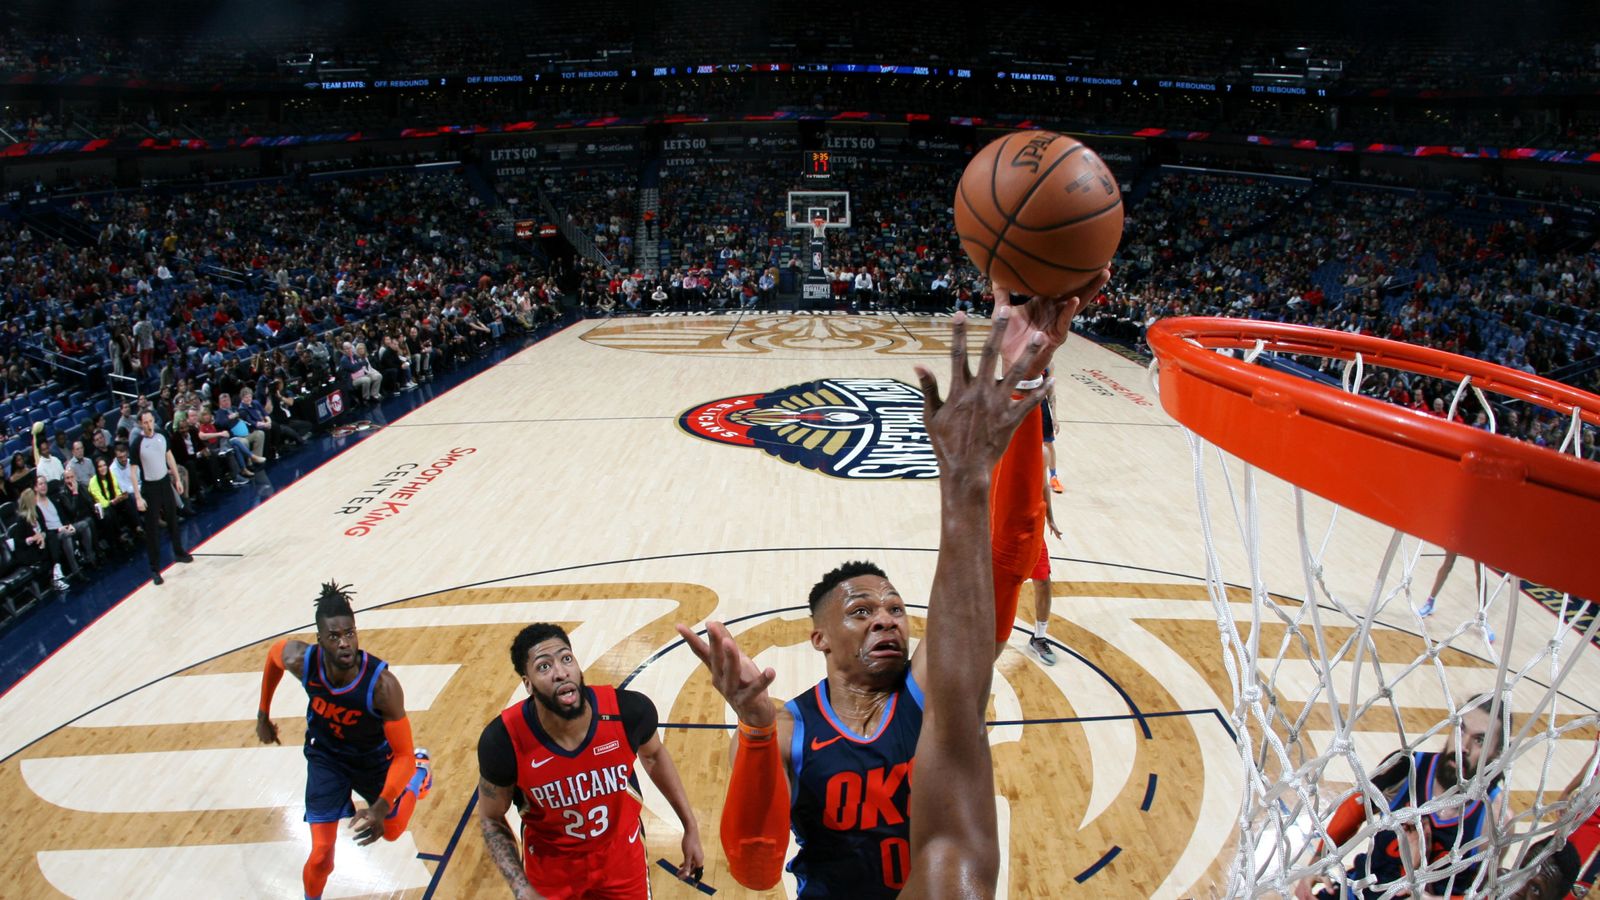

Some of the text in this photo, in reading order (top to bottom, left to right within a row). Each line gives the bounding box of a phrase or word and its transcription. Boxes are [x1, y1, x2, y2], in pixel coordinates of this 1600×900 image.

[578, 70, 619, 78] REBOUNDS
[1010, 72, 1057, 82] TEAM STATS:
[390, 79, 429, 88] REBOUNDS
[440, 78, 446, 86] 2
[484, 75, 523, 83] REBOUNDS
[1082, 77, 1122, 86] REBOUNDS
[1132, 79, 1138, 87] 4
[322, 80, 366, 89] TEAM STATS:
[1175, 81, 1216, 91] REBOUNDS
[1226, 84, 1232, 92] 7
[1267, 86, 1306, 95] REBOUNDS
[1317, 89, 1326, 97] 11
[663, 139, 691, 151] LET'S
[692, 137, 706, 149] GO
[827, 137, 858, 149] LET'S
[860, 137, 876, 149] GO
[598, 144, 634, 153] SeatGeek
[491, 148, 521, 161] LET'S
[522, 147, 537, 160] GO
[813, 152, 829, 161] 3:35
[685, 158, 695, 166] GO
[496, 167, 525, 176] LET'S GO
[698, 400, 749, 438] PELICANS
[848, 406, 941, 479] ORLEANS
[390, 446, 478, 501] SMOOTHIE
[334, 463, 418, 515] CENTER
[311, 696, 364, 726] OKC
[531, 764, 629, 809] PELICANS
[823, 757, 916, 831] OK
[563, 804, 610, 840] 23
[879, 837, 912, 890] 0
